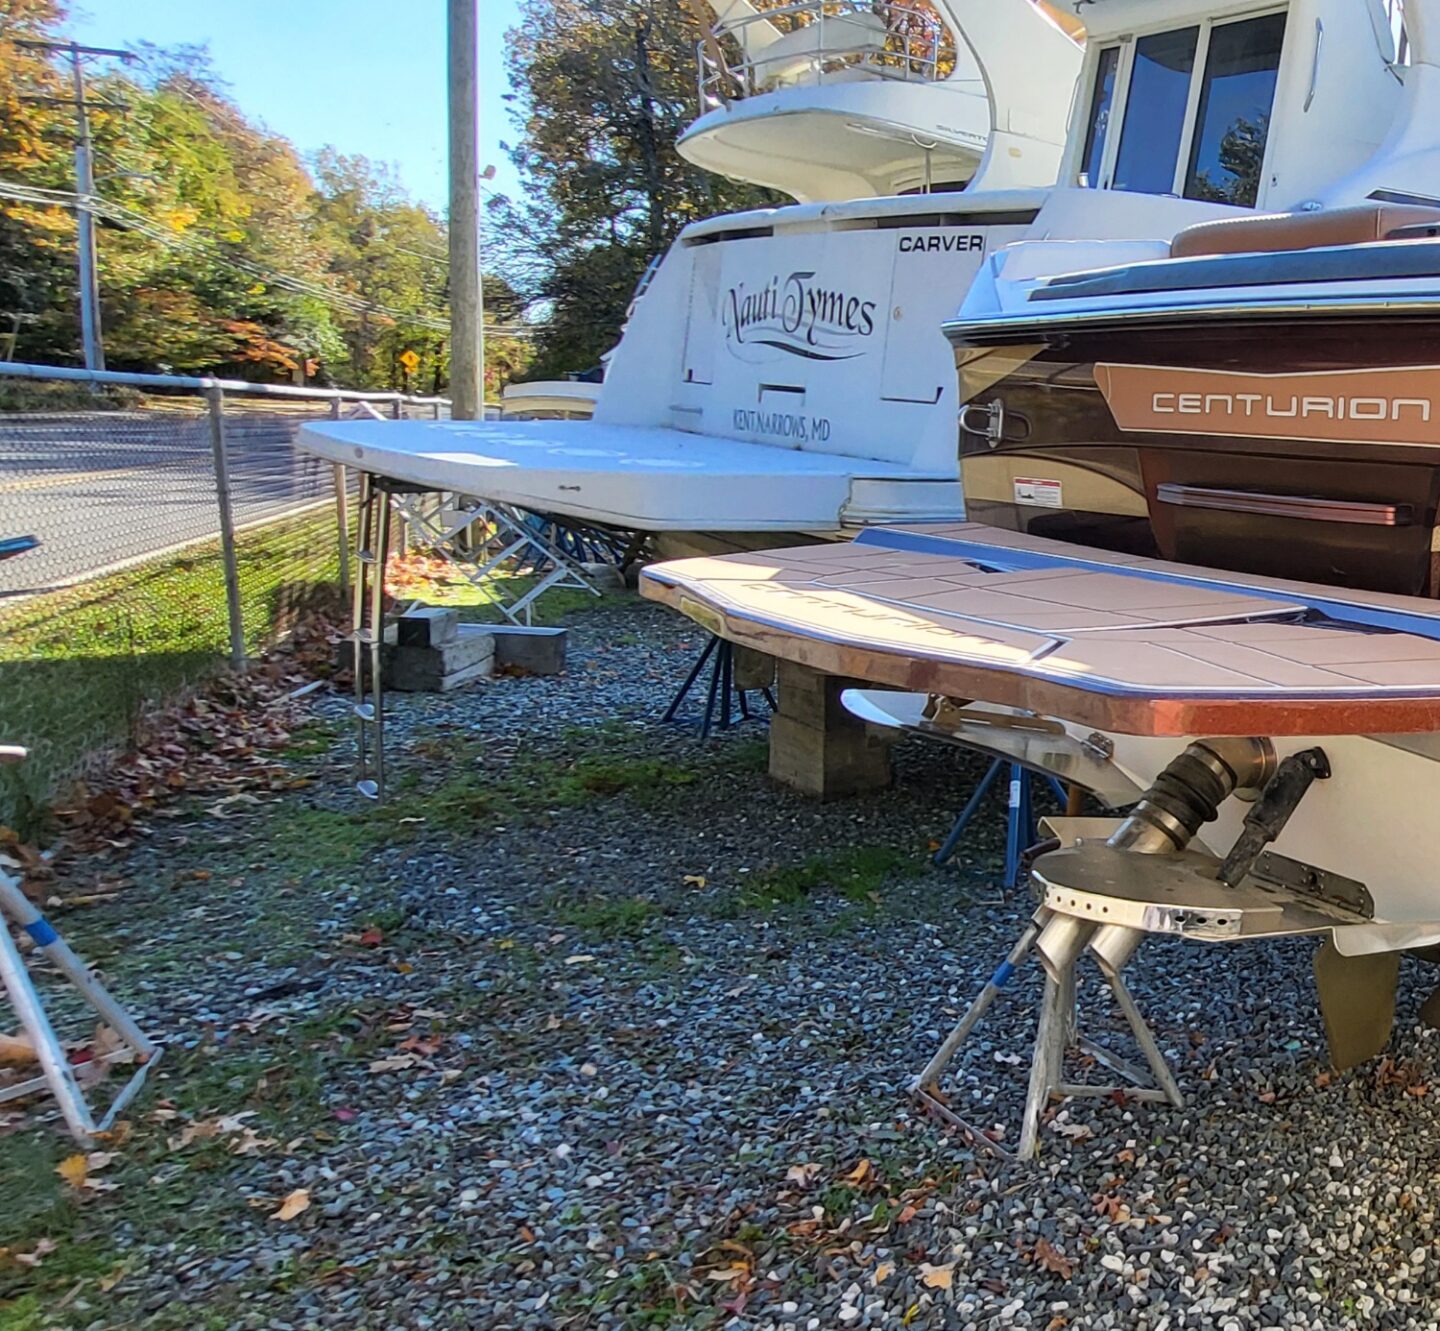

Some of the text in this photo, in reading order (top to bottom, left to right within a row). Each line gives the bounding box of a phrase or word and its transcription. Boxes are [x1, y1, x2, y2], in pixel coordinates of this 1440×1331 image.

[899, 234, 984, 252] CARVER
[722, 271, 877, 346] Nauti Tymes
[1152, 393, 1431, 421] CENTURION
[811, 417, 831, 441] MD
